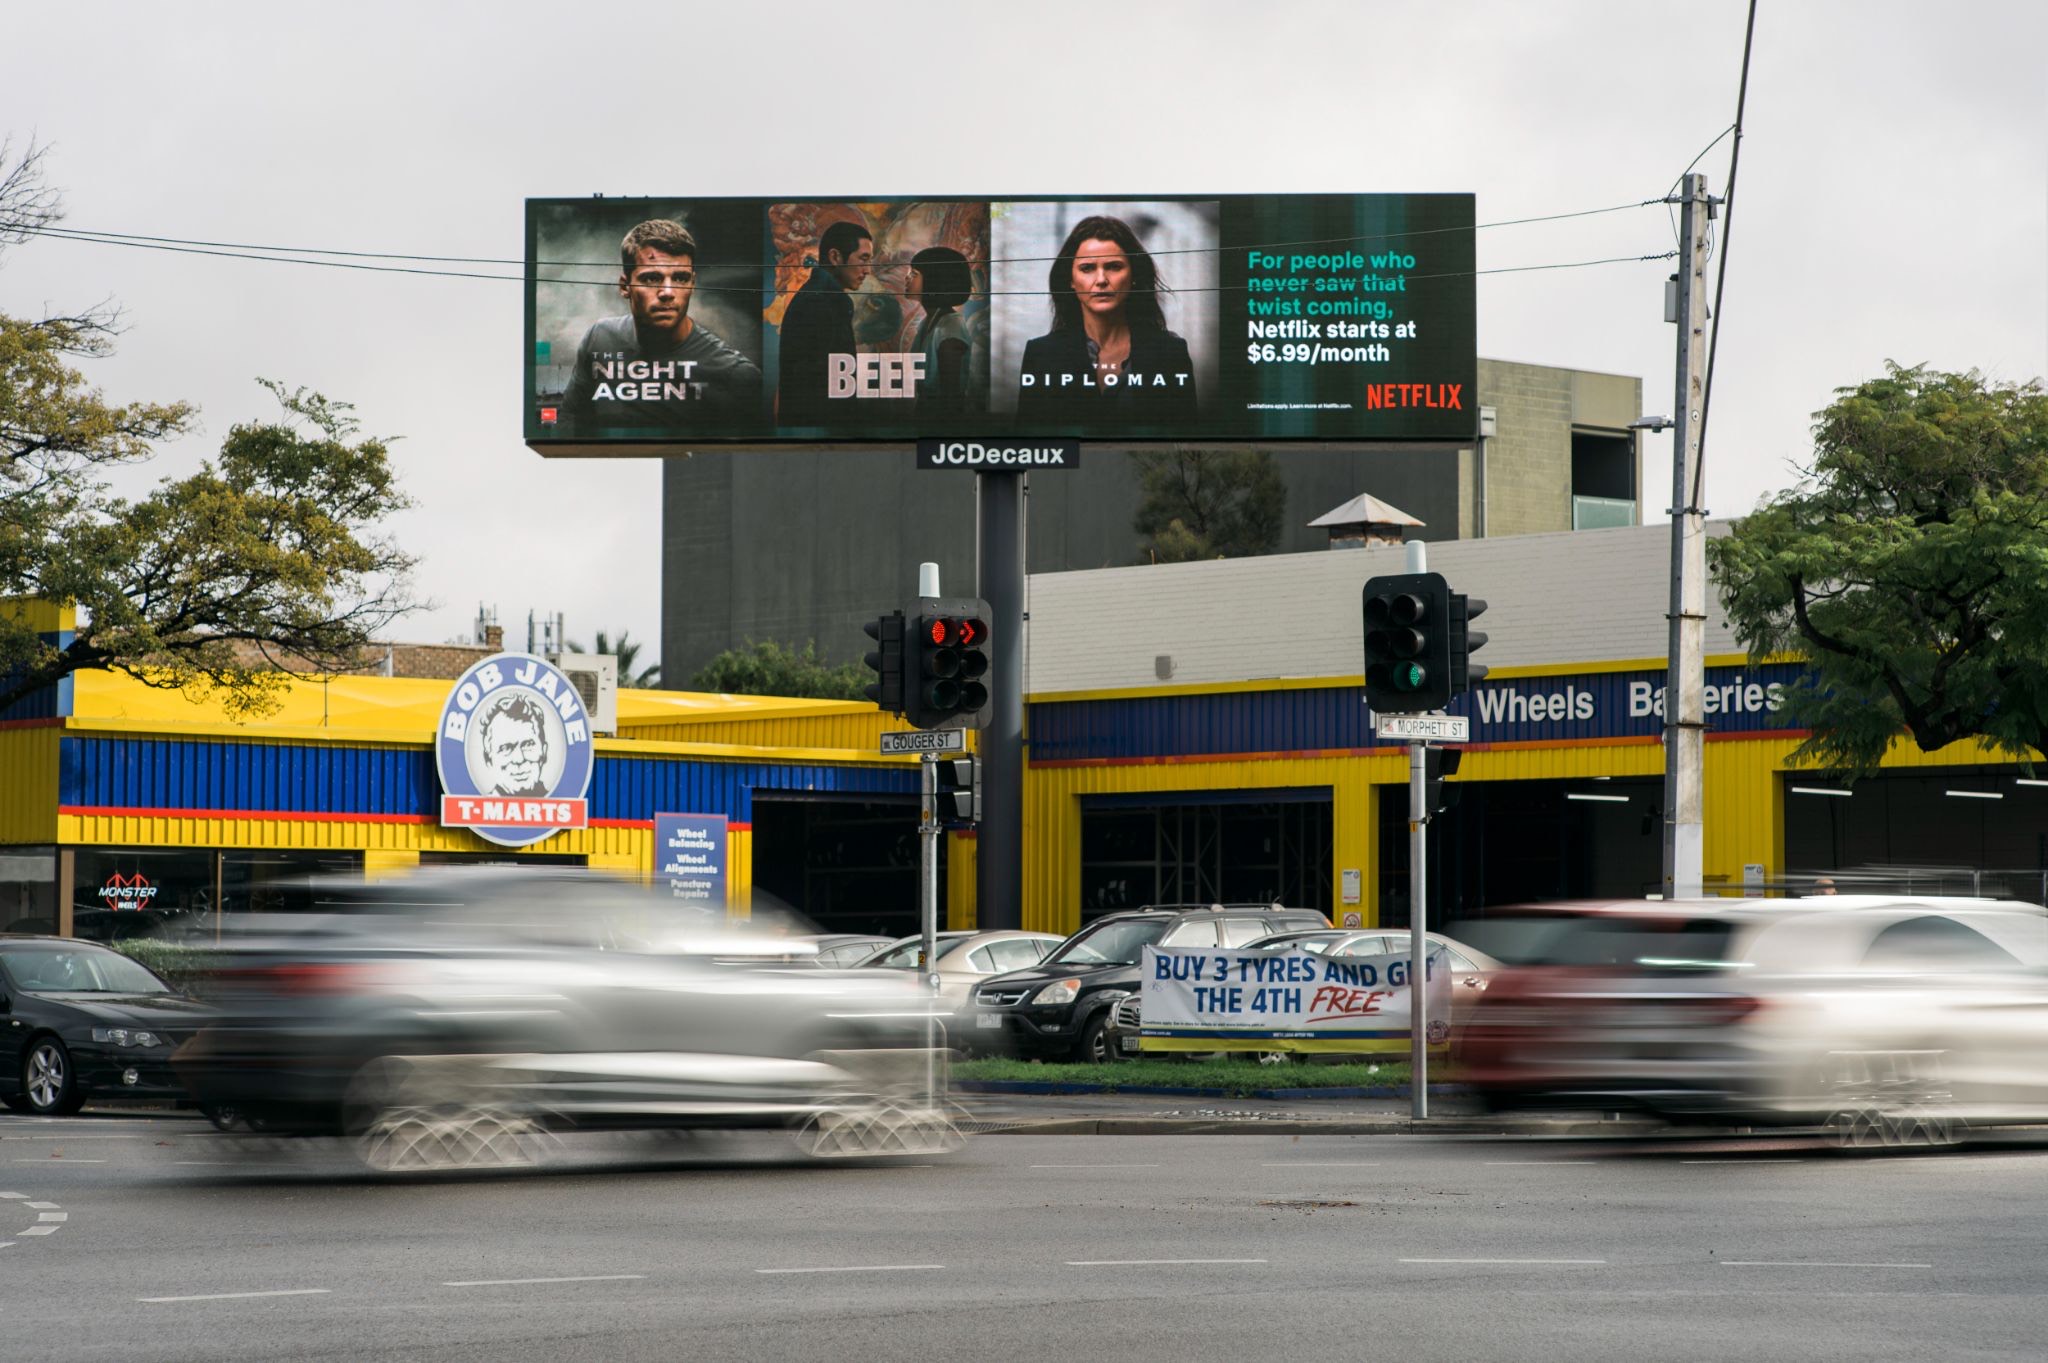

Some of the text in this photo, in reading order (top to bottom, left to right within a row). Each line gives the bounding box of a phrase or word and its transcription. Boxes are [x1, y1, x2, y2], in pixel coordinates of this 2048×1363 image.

[1248, 250, 1416, 273] For people who
[1248, 274, 1406, 292] never saw that
[1248, 297, 1394, 319] twist coming,
[1248, 319, 1416, 339] Netflix starts at
[1247, 342, 1390, 366] $6.99/month
[592, 360, 698, 380] NIGHT
[828, 353, 926, 398] BEEF
[1021, 373, 1189, 386] DIPLOMAT
[592, 382, 709, 400] AGENT
[1367, 384, 1462, 410] NETFLIX
[931, 443, 1064, 464] JCDecaux
[445, 661, 587, 745] BOB JANE
[1477, 685, 1594, 724] Wheels
[1630, 675, 1785, 717] Baeries
[1399, 720, 1462, 735] MORPHETT ST
[893, 734, 950, 749] GOUGER ST
[458, 801, 572, 822] T-MARTS
[677, 829, 707, 838] Wheel
[669, 838, 715, 850] Balancing
[676, 854, 706, 863] Wheel
[665, 864, 718, 875] Alignments
[99, 887, 157, 897] MONSTER
[671, 879, 711, 888] Puncture
[673, 889, 709, 899] Repairs
[1156, 955, 1206, 980] BUY
[1213, 957, 1229, 981] 3
[1237, 957, 1316, 982] TYRES
[1324, 961, 1377, 987] AND
[1194, 988, 1242, 1013] THE
[1251, 988, 1301, 1013] 4TH
